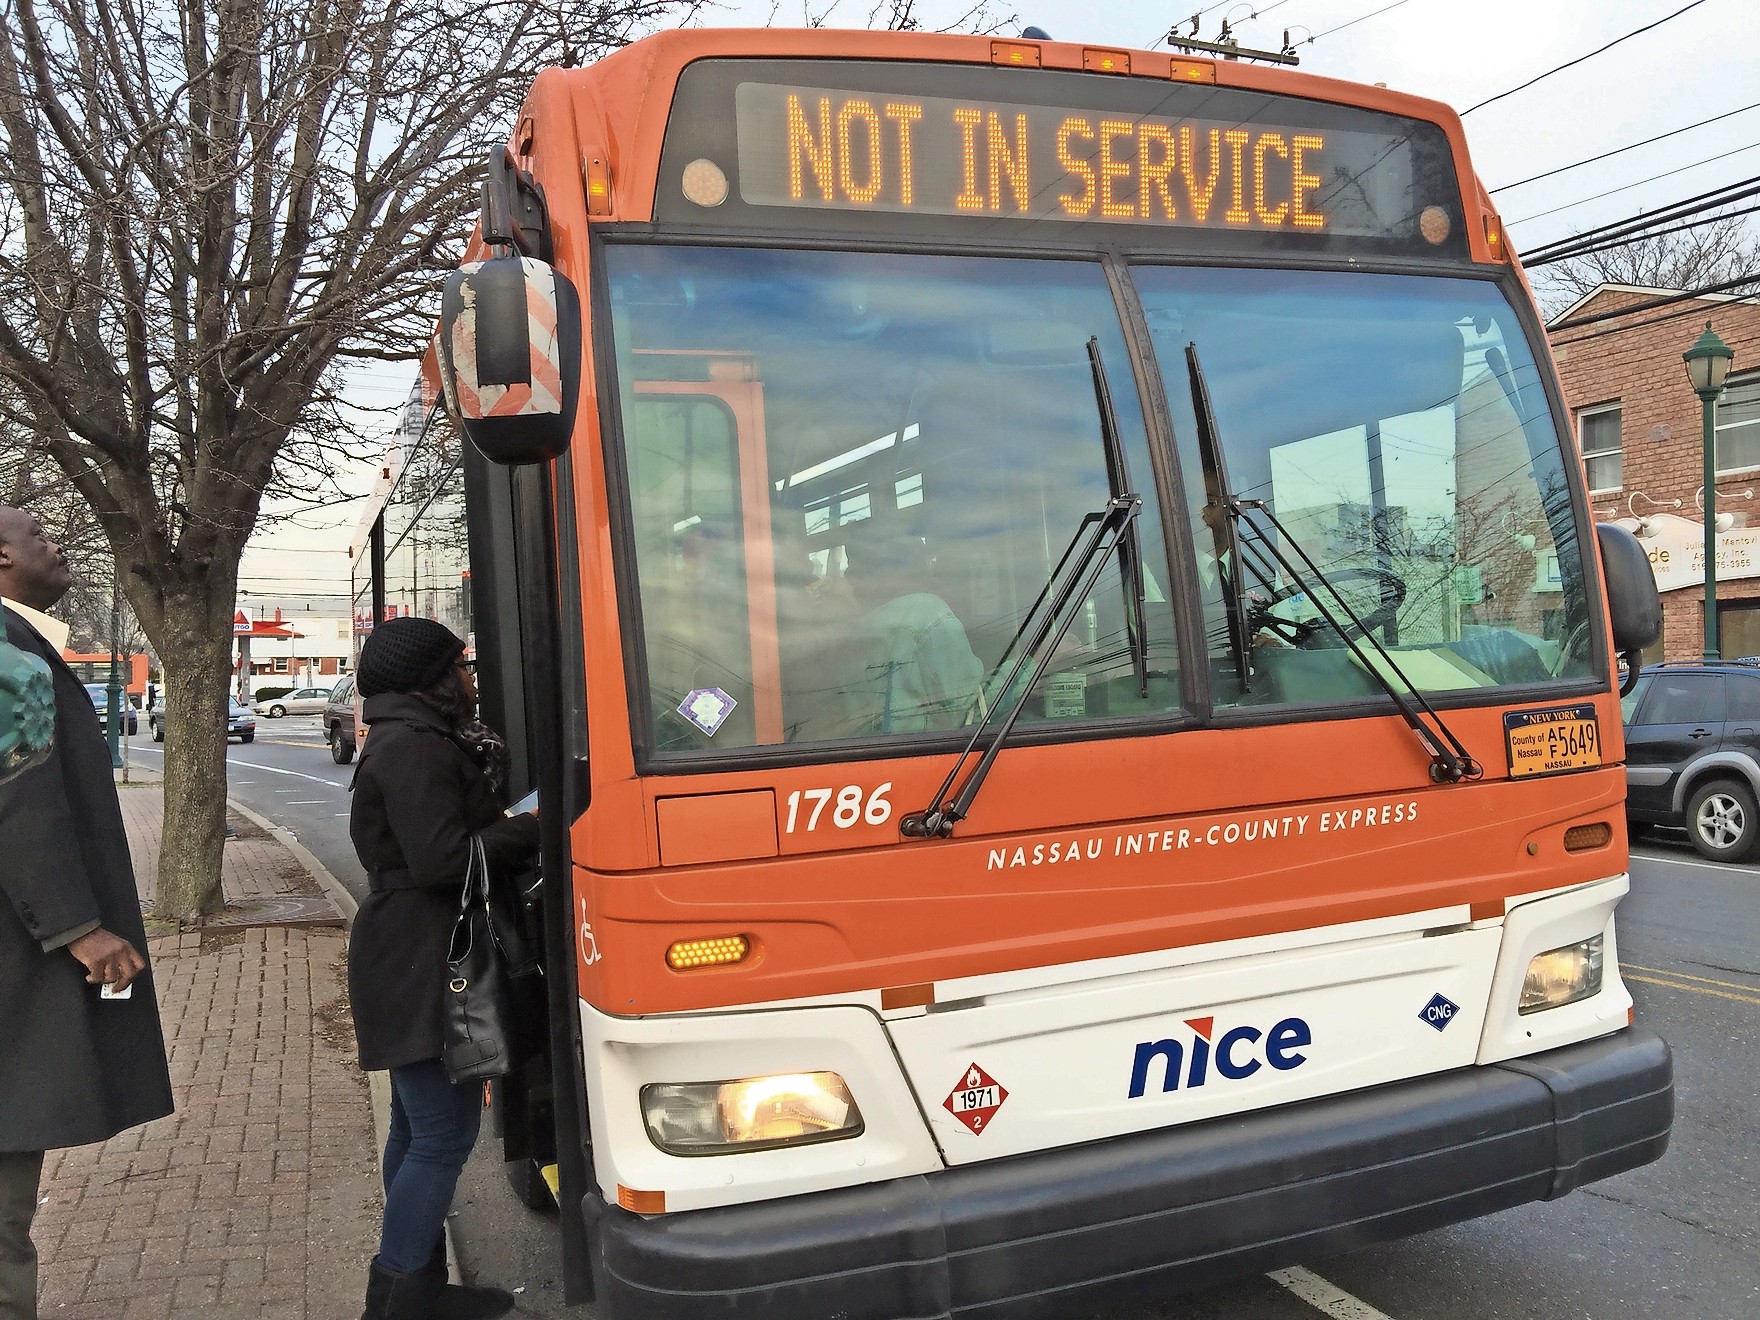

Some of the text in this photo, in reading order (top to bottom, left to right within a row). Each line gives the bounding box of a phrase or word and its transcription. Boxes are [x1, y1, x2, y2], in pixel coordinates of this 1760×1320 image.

[787, 94, 1325, 229] NOT IN SERVICE
[1529, 710, 1577, 724] NEW YORK
[1512, 733, 1545, 746] County of
[1517, 749, 1543, 759] Nassau
[1544, 760, 1572, 770] NASSAU
[785, 782, 893, 834] 1786
[987, 801, 1419, 871] NASSAU INTER-COUNTY EXPRESS
[1427, 1003, 1452, 1022] CNG
[1128, 1016, 1312, 1099] nice
[960, 1086, 995, 1110] 1971
[973, 1115, 982, 1130] 2
